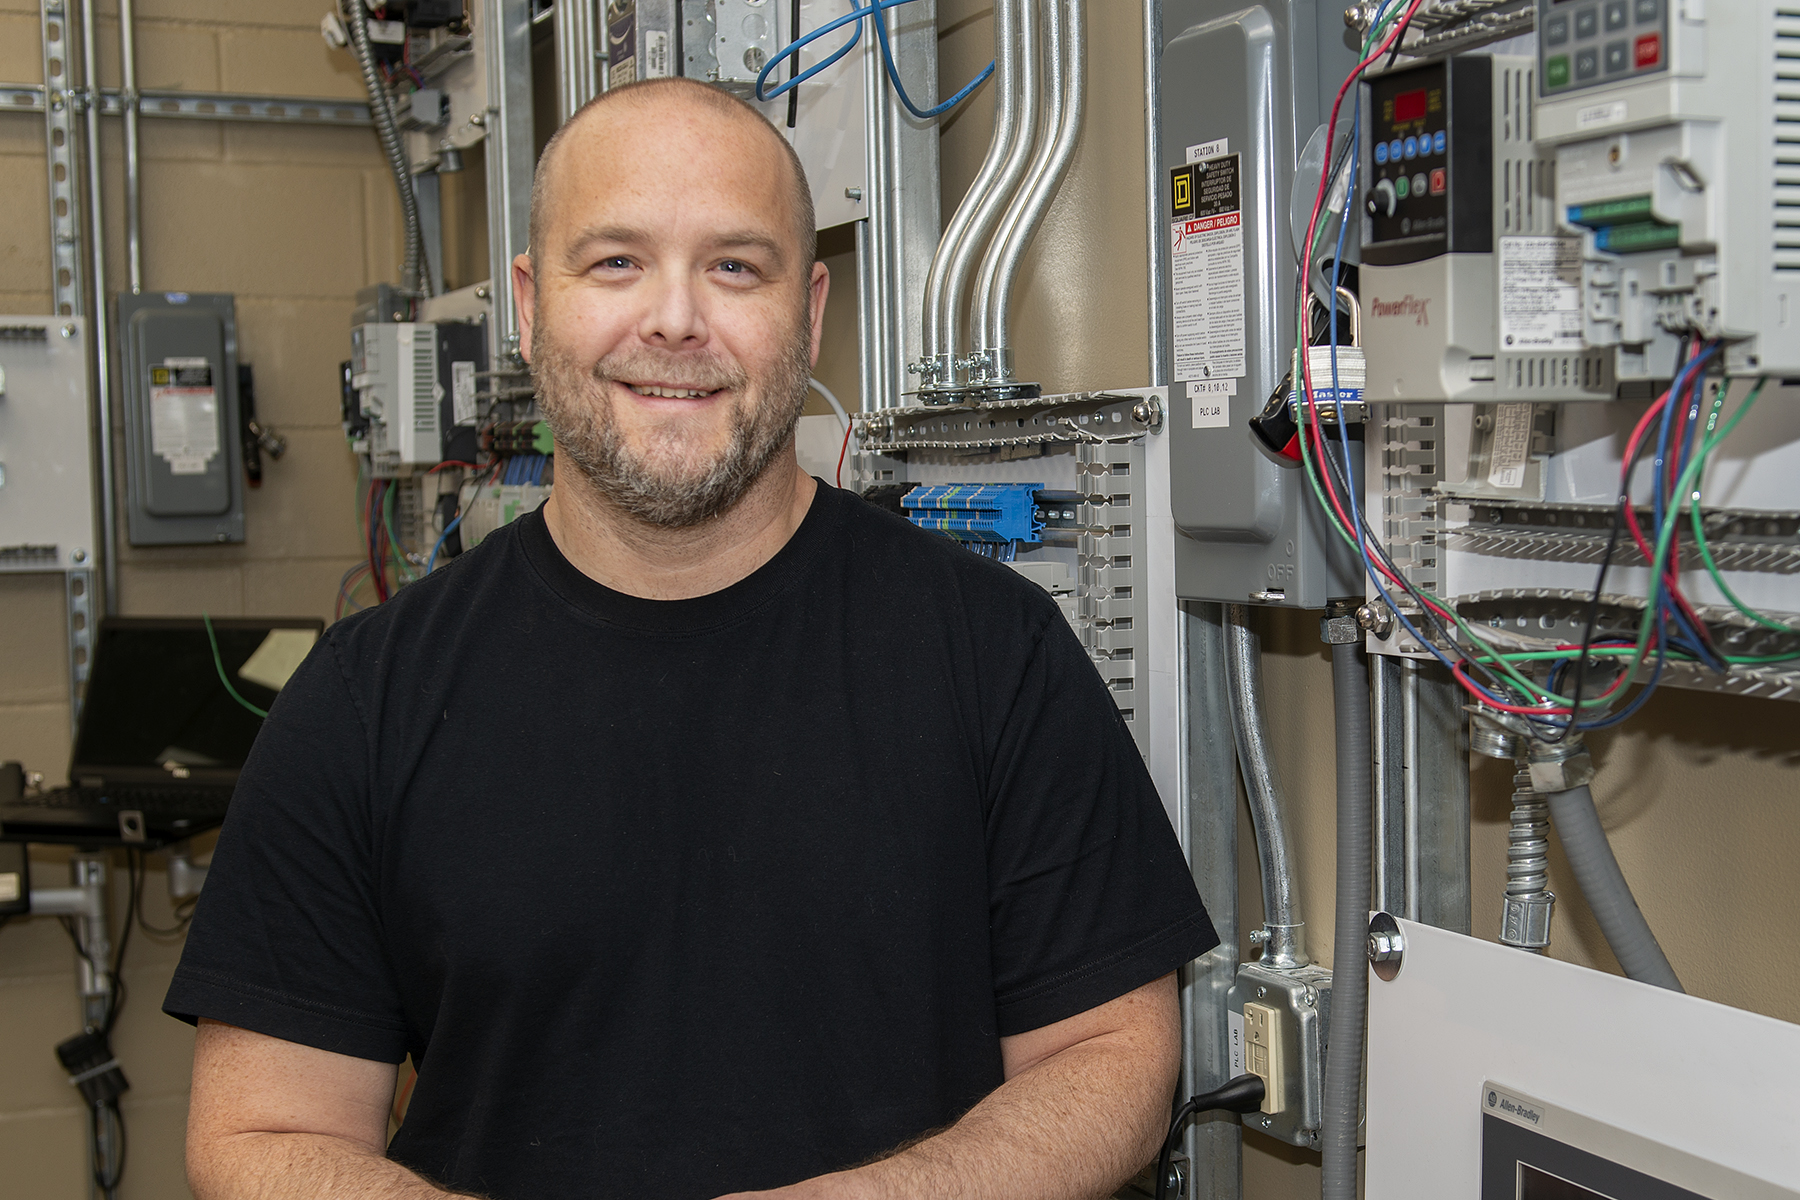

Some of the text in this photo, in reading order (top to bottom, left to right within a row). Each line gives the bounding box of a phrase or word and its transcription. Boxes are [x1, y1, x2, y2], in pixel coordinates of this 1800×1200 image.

[1194, 143, 1220, 158] STATION 8
[1221, 160, 1231, 169] DUTY
[1206, 167, 1235, 179] SAFETY SWITCH
[1201, 176, 1226, 188] INTERRUPTOR
[1203, 184, 1224, 196] SEGURIDAD
[1201, 190, 1233, 203] SERVICIO PESADO
[1193, 219, 1213, 232] DANGER
[1216, 215, 1238, 227] PELIGRO
[1199, 406, 1221, 416] PLC LAB
[1267, 563, 1295, 582] OFF
[1499, 1098, 1541, 1125] Allen-Bradley
